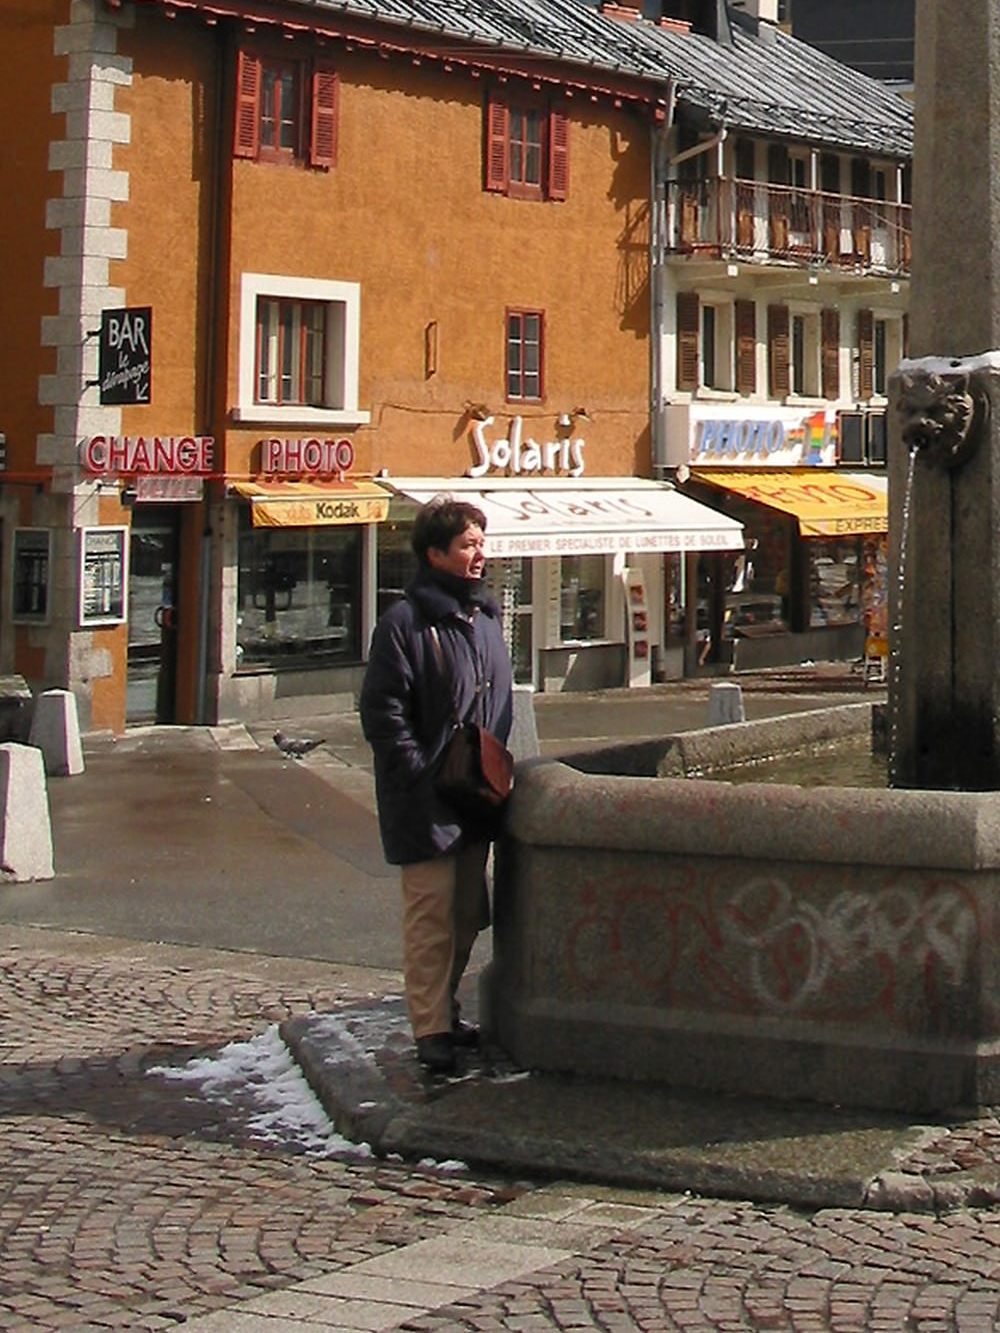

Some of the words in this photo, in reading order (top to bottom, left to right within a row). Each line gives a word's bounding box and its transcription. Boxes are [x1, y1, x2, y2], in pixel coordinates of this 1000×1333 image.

[109, 313, 149, 354] BAR
[86, 434, 214, 472] CHANGE
[468, 415, 585, 477] Solaris
[702, 419, 785, 453] PHOTO
[267, 436, 355, 472] PHOTO
[315, 502, 360, 520] Kodak
[479, 490, 653, 521] Solaris
[490, 539, 504, 553] LE
[508, 538, 550, 552] PREMIER
[619, 536, 630, 548] DE
[635, 535, 680, 547] LUNETTES
[684, 534, 696, 547] DE
